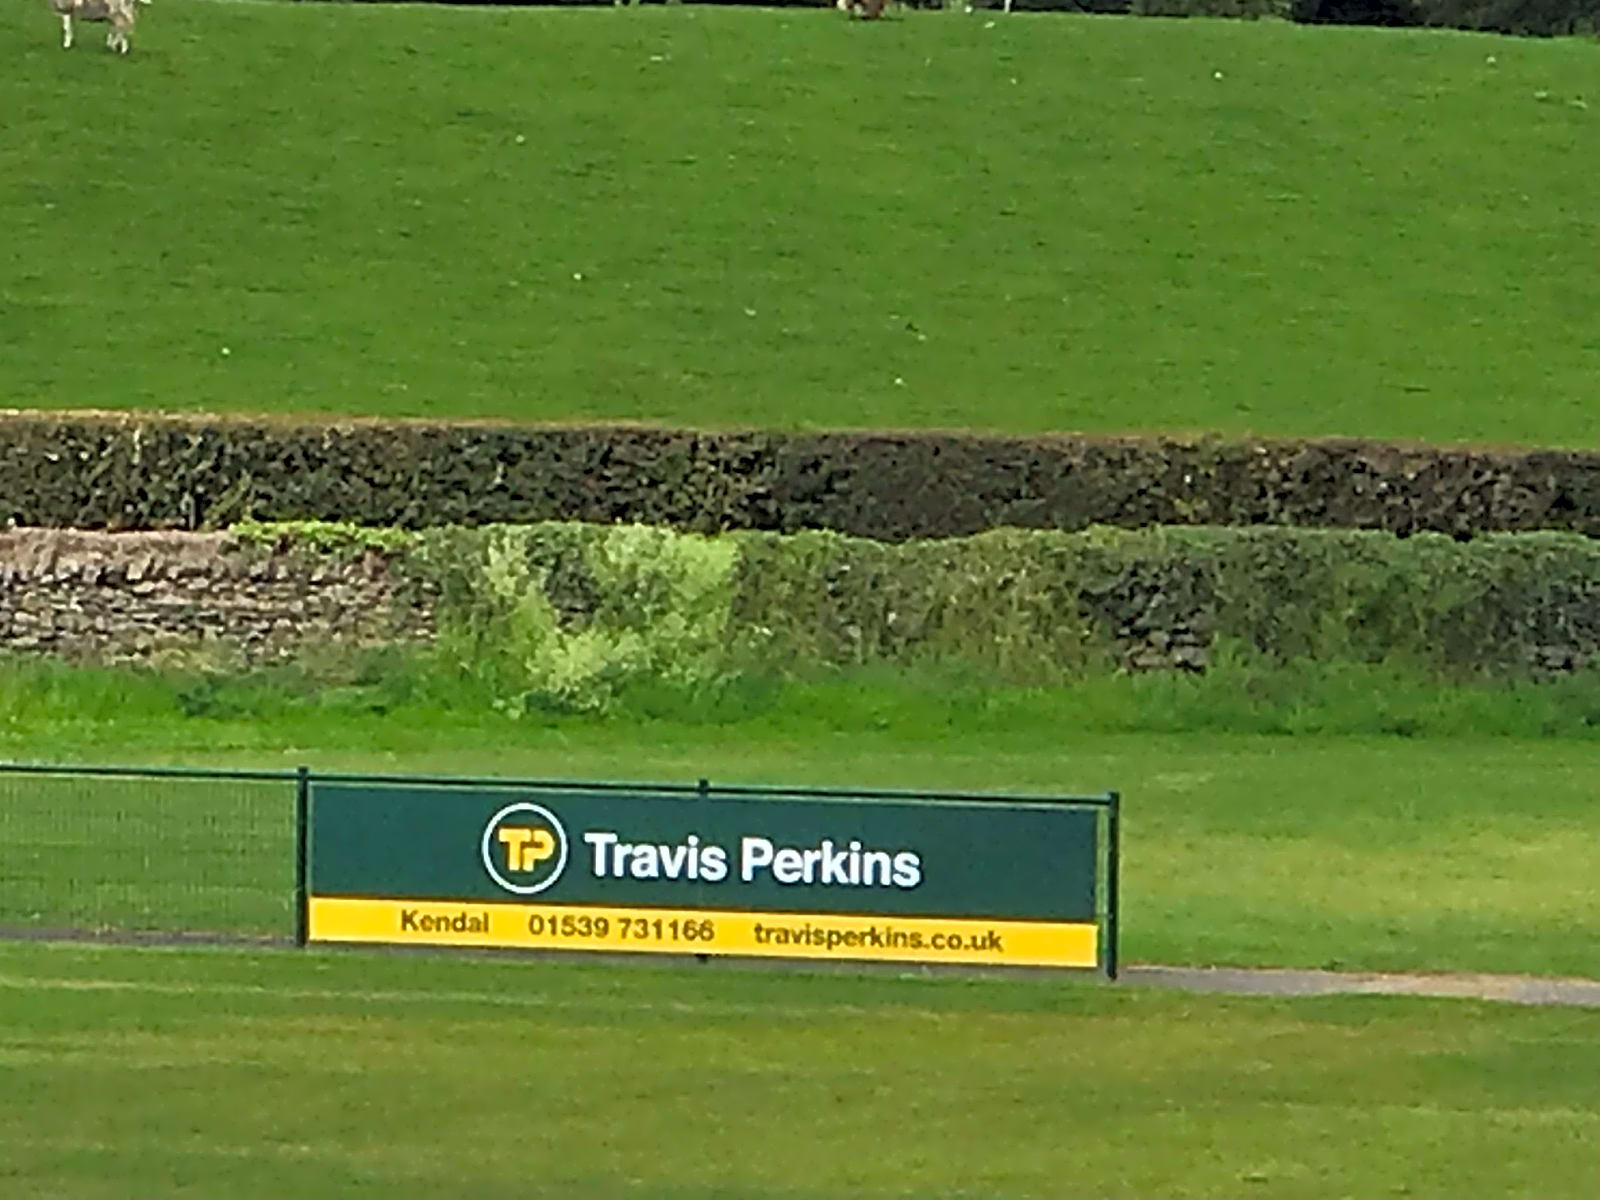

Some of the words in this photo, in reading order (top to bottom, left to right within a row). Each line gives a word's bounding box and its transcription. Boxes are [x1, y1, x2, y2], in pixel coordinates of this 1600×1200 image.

[498, 828, 556, 872] TP
[584, 832, 728, 882] Travis
[741, 837, 922, 888] Perkins
[401, 908, 490, 934] Kendal
[528, 914, 610, 938] 01539
[619, 917, 715, 942] 731166
[754, 922, 1004, 953] travisperkins.co.uk
